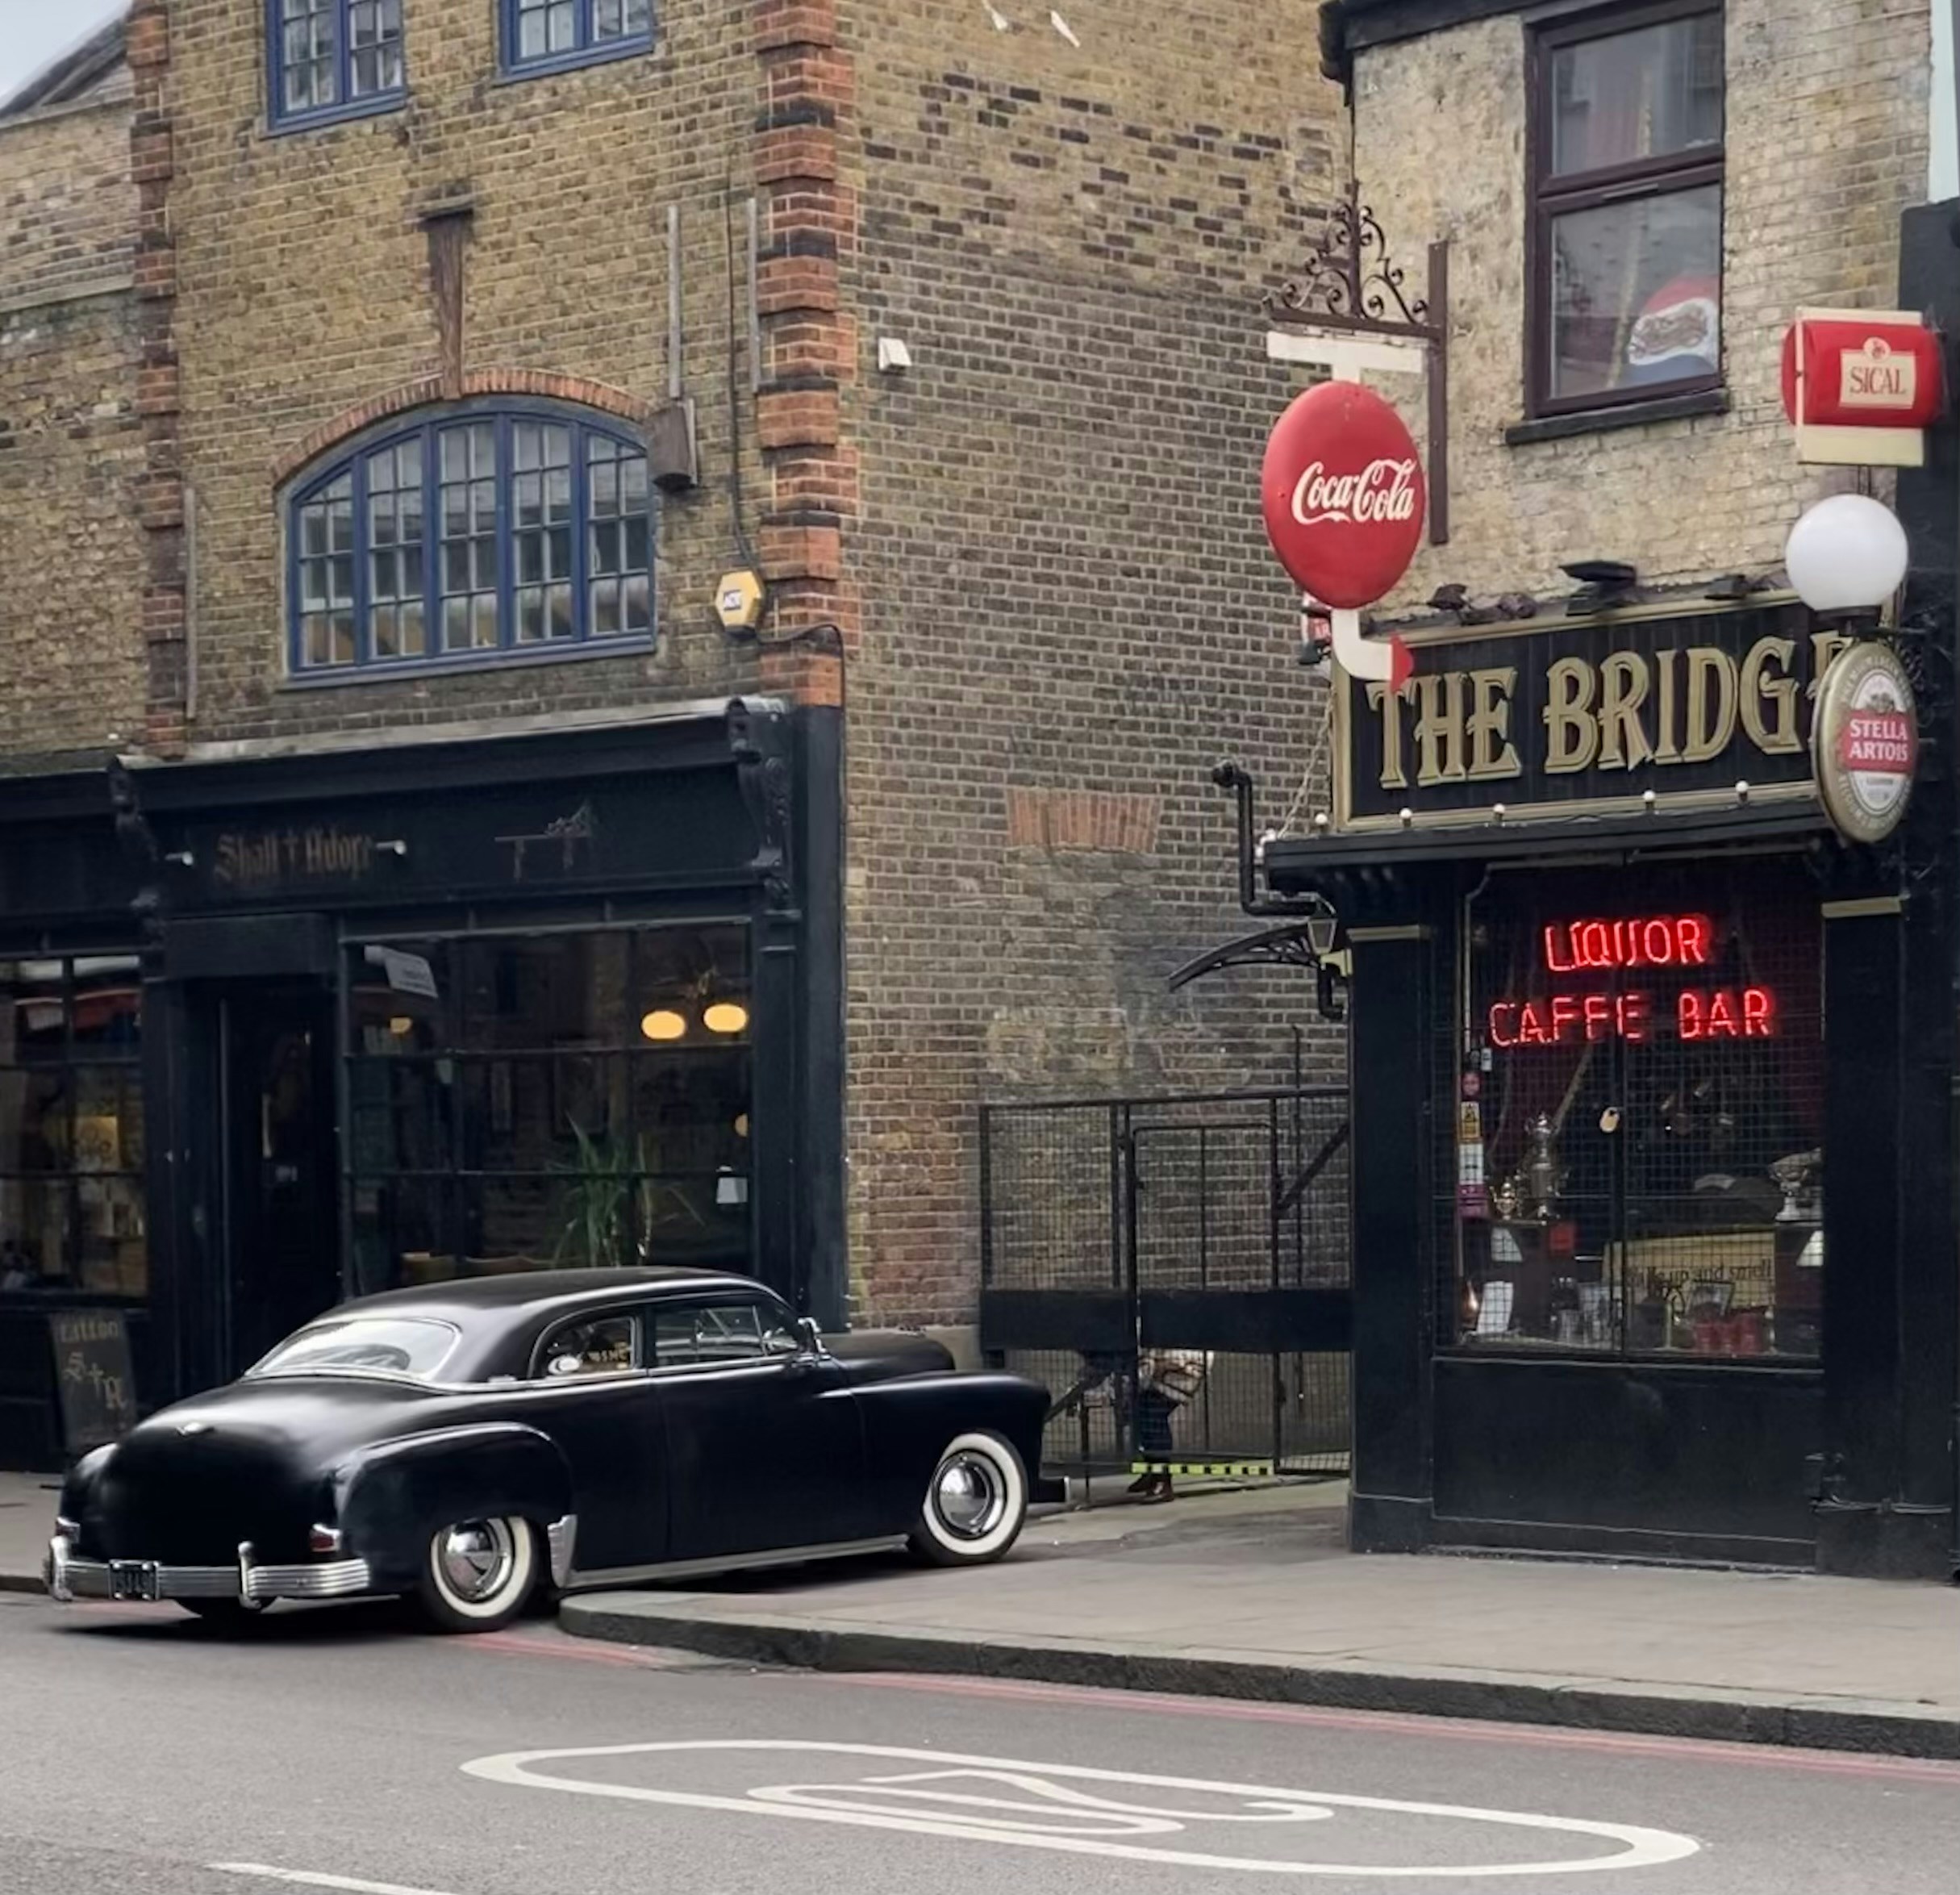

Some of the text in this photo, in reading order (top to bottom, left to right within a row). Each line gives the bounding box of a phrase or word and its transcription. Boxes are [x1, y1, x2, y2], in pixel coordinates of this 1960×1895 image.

[1849, 366, 1907, 395] SICAL
[1292, 458, 1417, 524] Coca-Cola
[1366, 666, 1523, 790] THE
[1849, 718, 1908, 741] STELLA
[1849, 740, 1909, 762] ARTOIS
[1545, 917, 1706, 972] LIQUOR
[1489, 988, 1771, 1048] CAFFE BAR
[1695, 1262, 1724, 1280] and
[1729, 1258, 1772, 1281] smell
